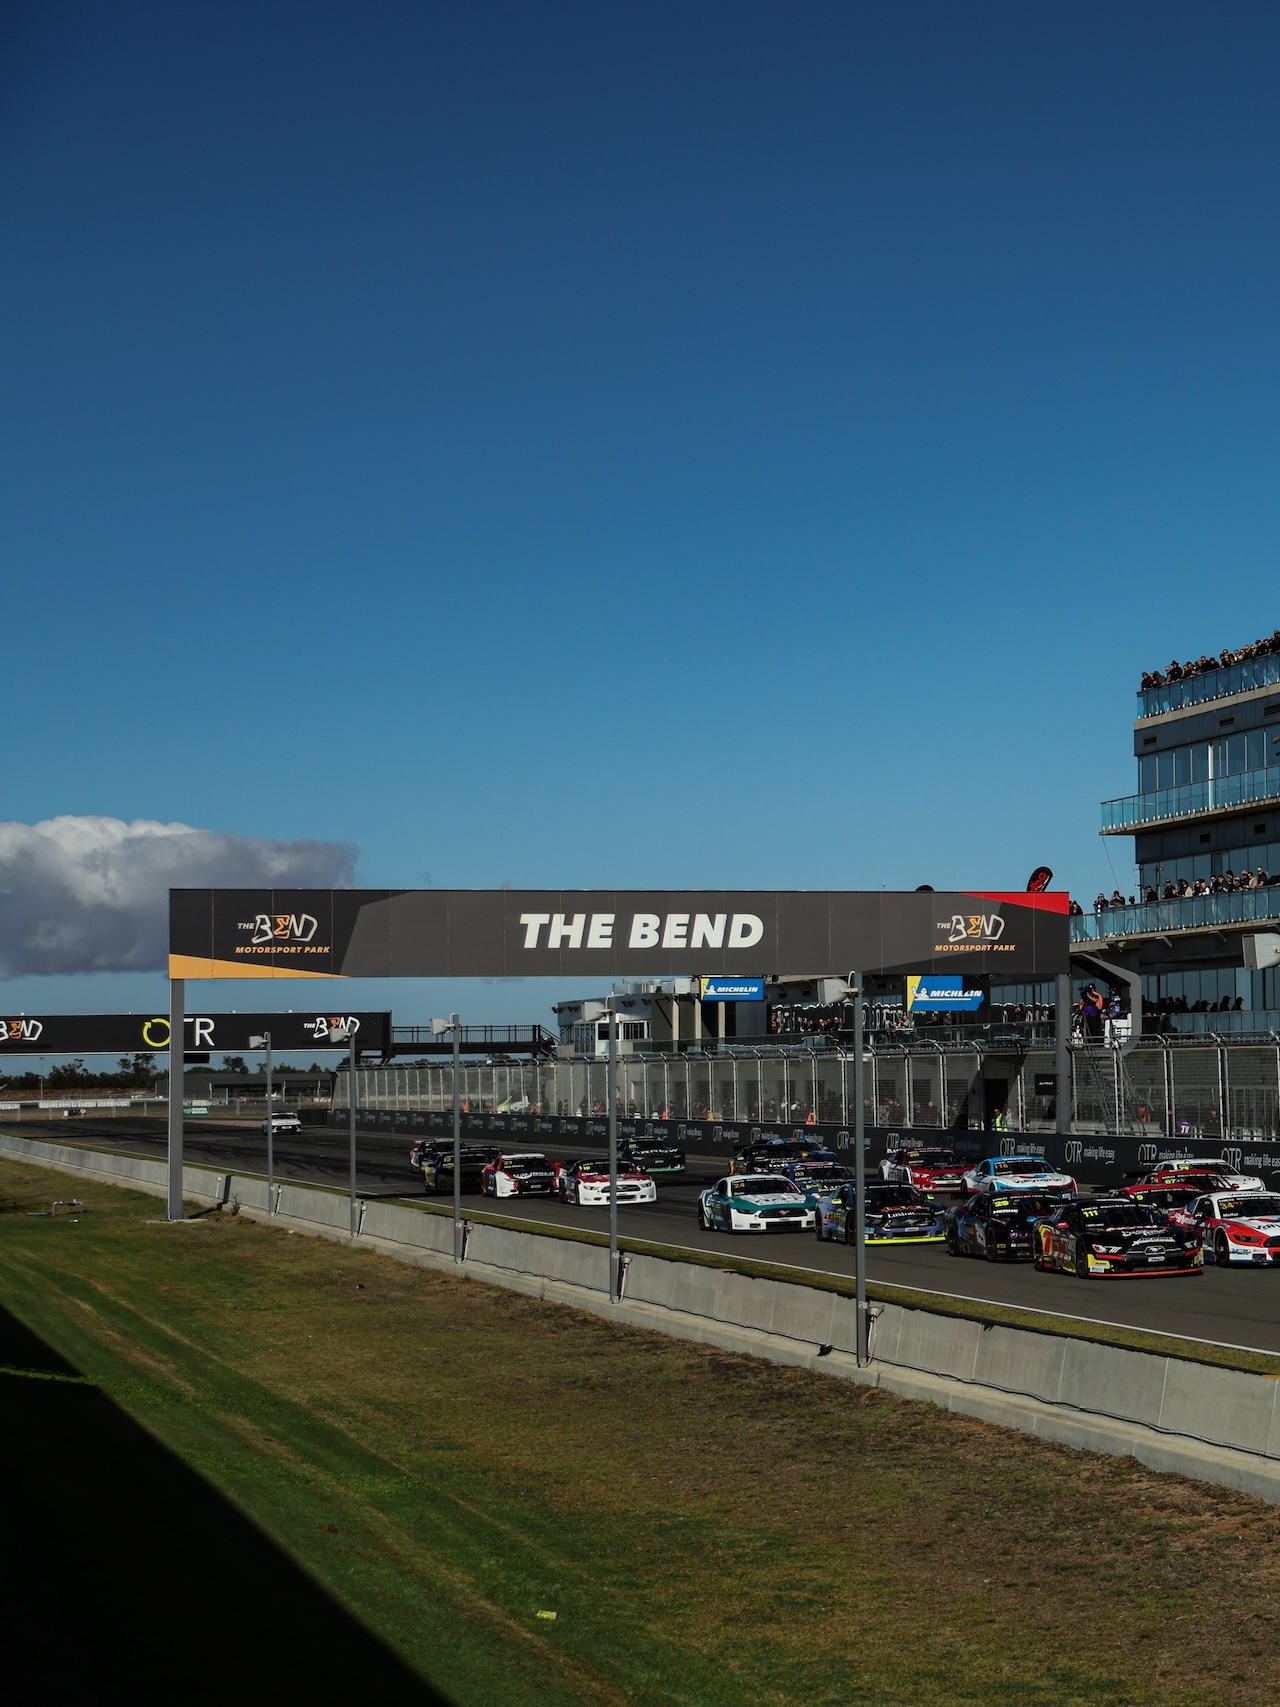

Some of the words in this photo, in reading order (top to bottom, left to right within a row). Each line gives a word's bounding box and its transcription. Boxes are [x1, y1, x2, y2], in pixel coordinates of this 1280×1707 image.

[237, 922, 255, 930] THE
[251, 913, 318, 944] BEND
[519, 913, 615, 948] THE
[628, 913, 764, 948] BEND
[948, 914, 1005, 943] BEND
[235, 946, 302, 954] MOTORSPORT
[304, 946, 330, 954] PARK
[934, 944, 992, 952] MOTORSPORT
[993, 944, 1016, 952] PARK
[1221, 1147, 1242, 1171] OTR
[1244, 1153, 1263, 1169] making
[1263, 1153, 1271, 1167] life
[1220, 1201, 1235, 1210] 34
[1083, 1210, 1100, 1218] 111
